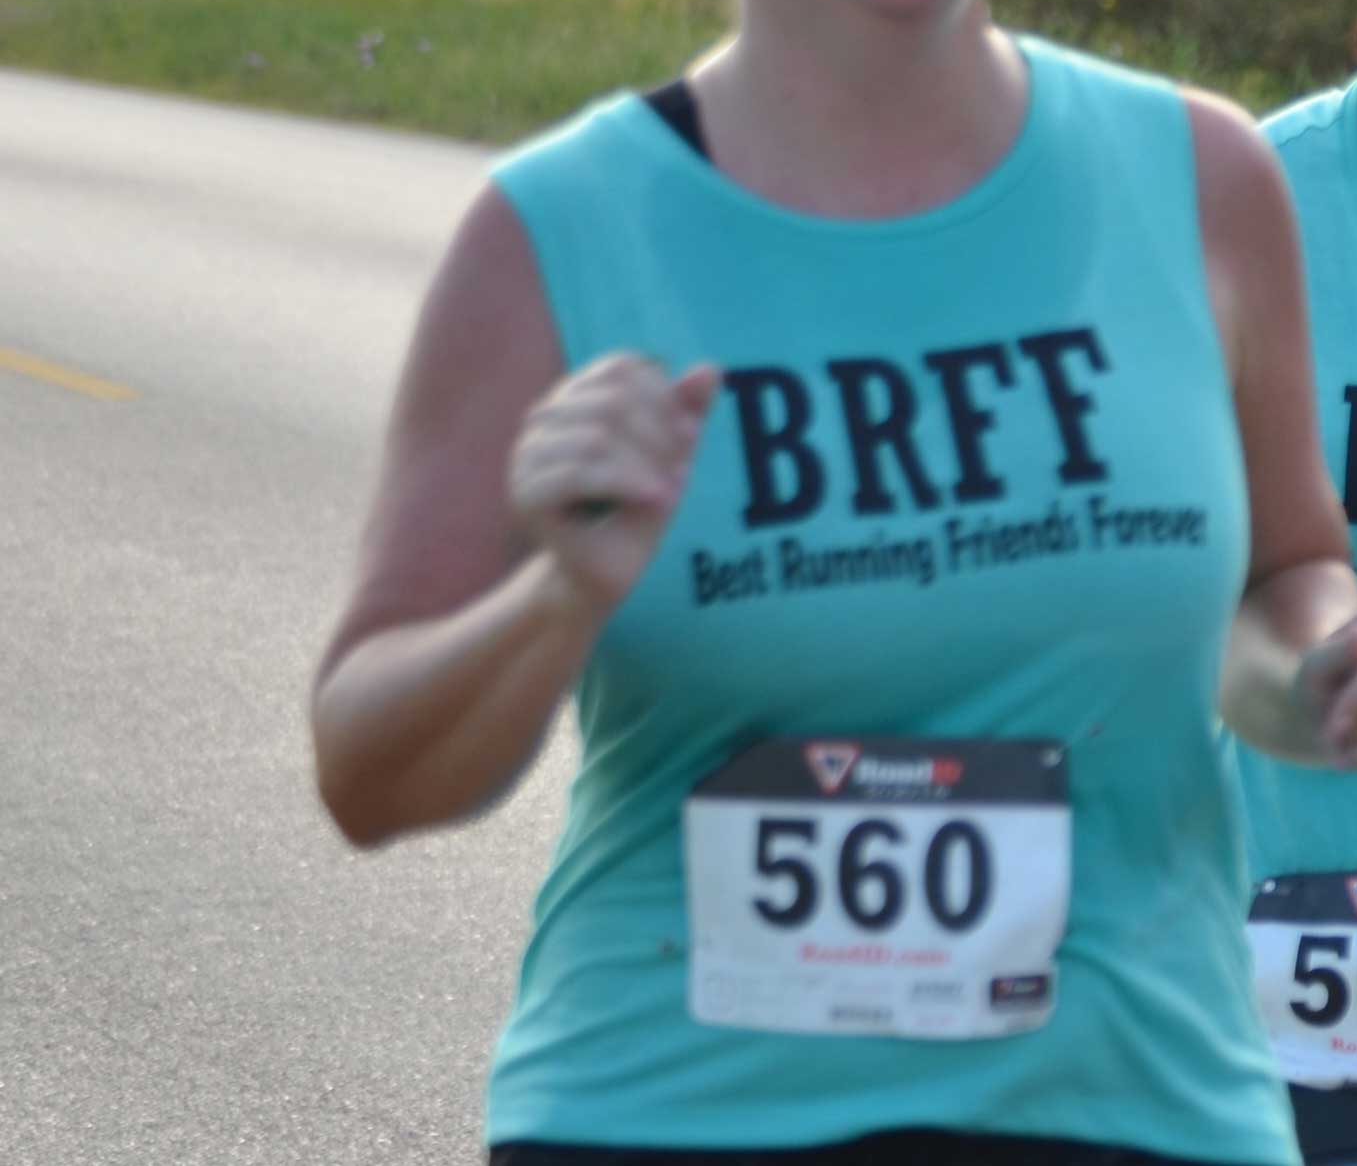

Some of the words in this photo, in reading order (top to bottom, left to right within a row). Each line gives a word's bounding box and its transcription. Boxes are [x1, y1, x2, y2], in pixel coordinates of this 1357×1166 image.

[722, 327, 1112, 529] BRFF
[690, 546, 768, 608] Best
[778, 532, 938, 589] Running
[946, 502, 1076, 573] Friends
[751, 817, 994, 933] 560
